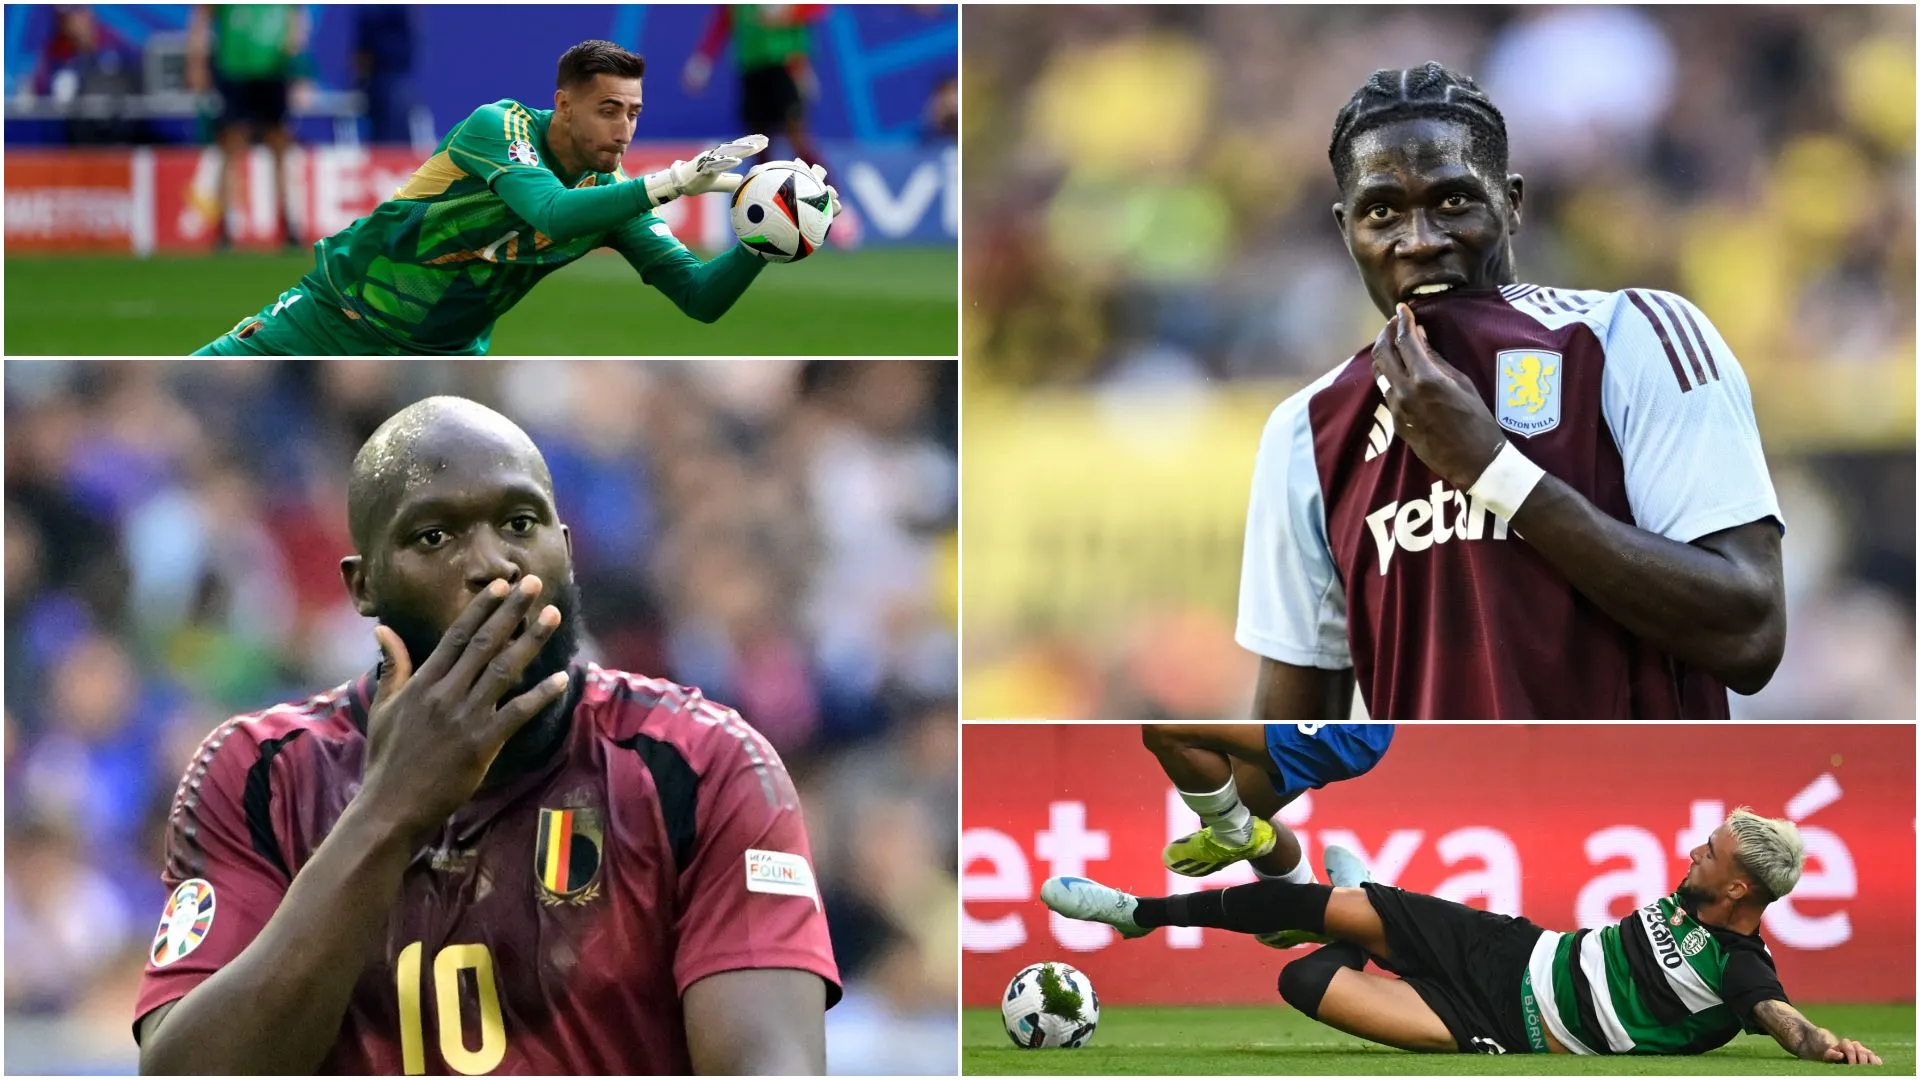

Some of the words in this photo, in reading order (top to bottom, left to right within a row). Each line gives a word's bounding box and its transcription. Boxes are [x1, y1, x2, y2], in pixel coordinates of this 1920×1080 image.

[1502, 416, 1530, 429] ASTON
[1531, 416, 1555, 429] VILLA
[397, 941, 507, 1076] 10
[1524, 995, 1544, 1050] BJÖRN
